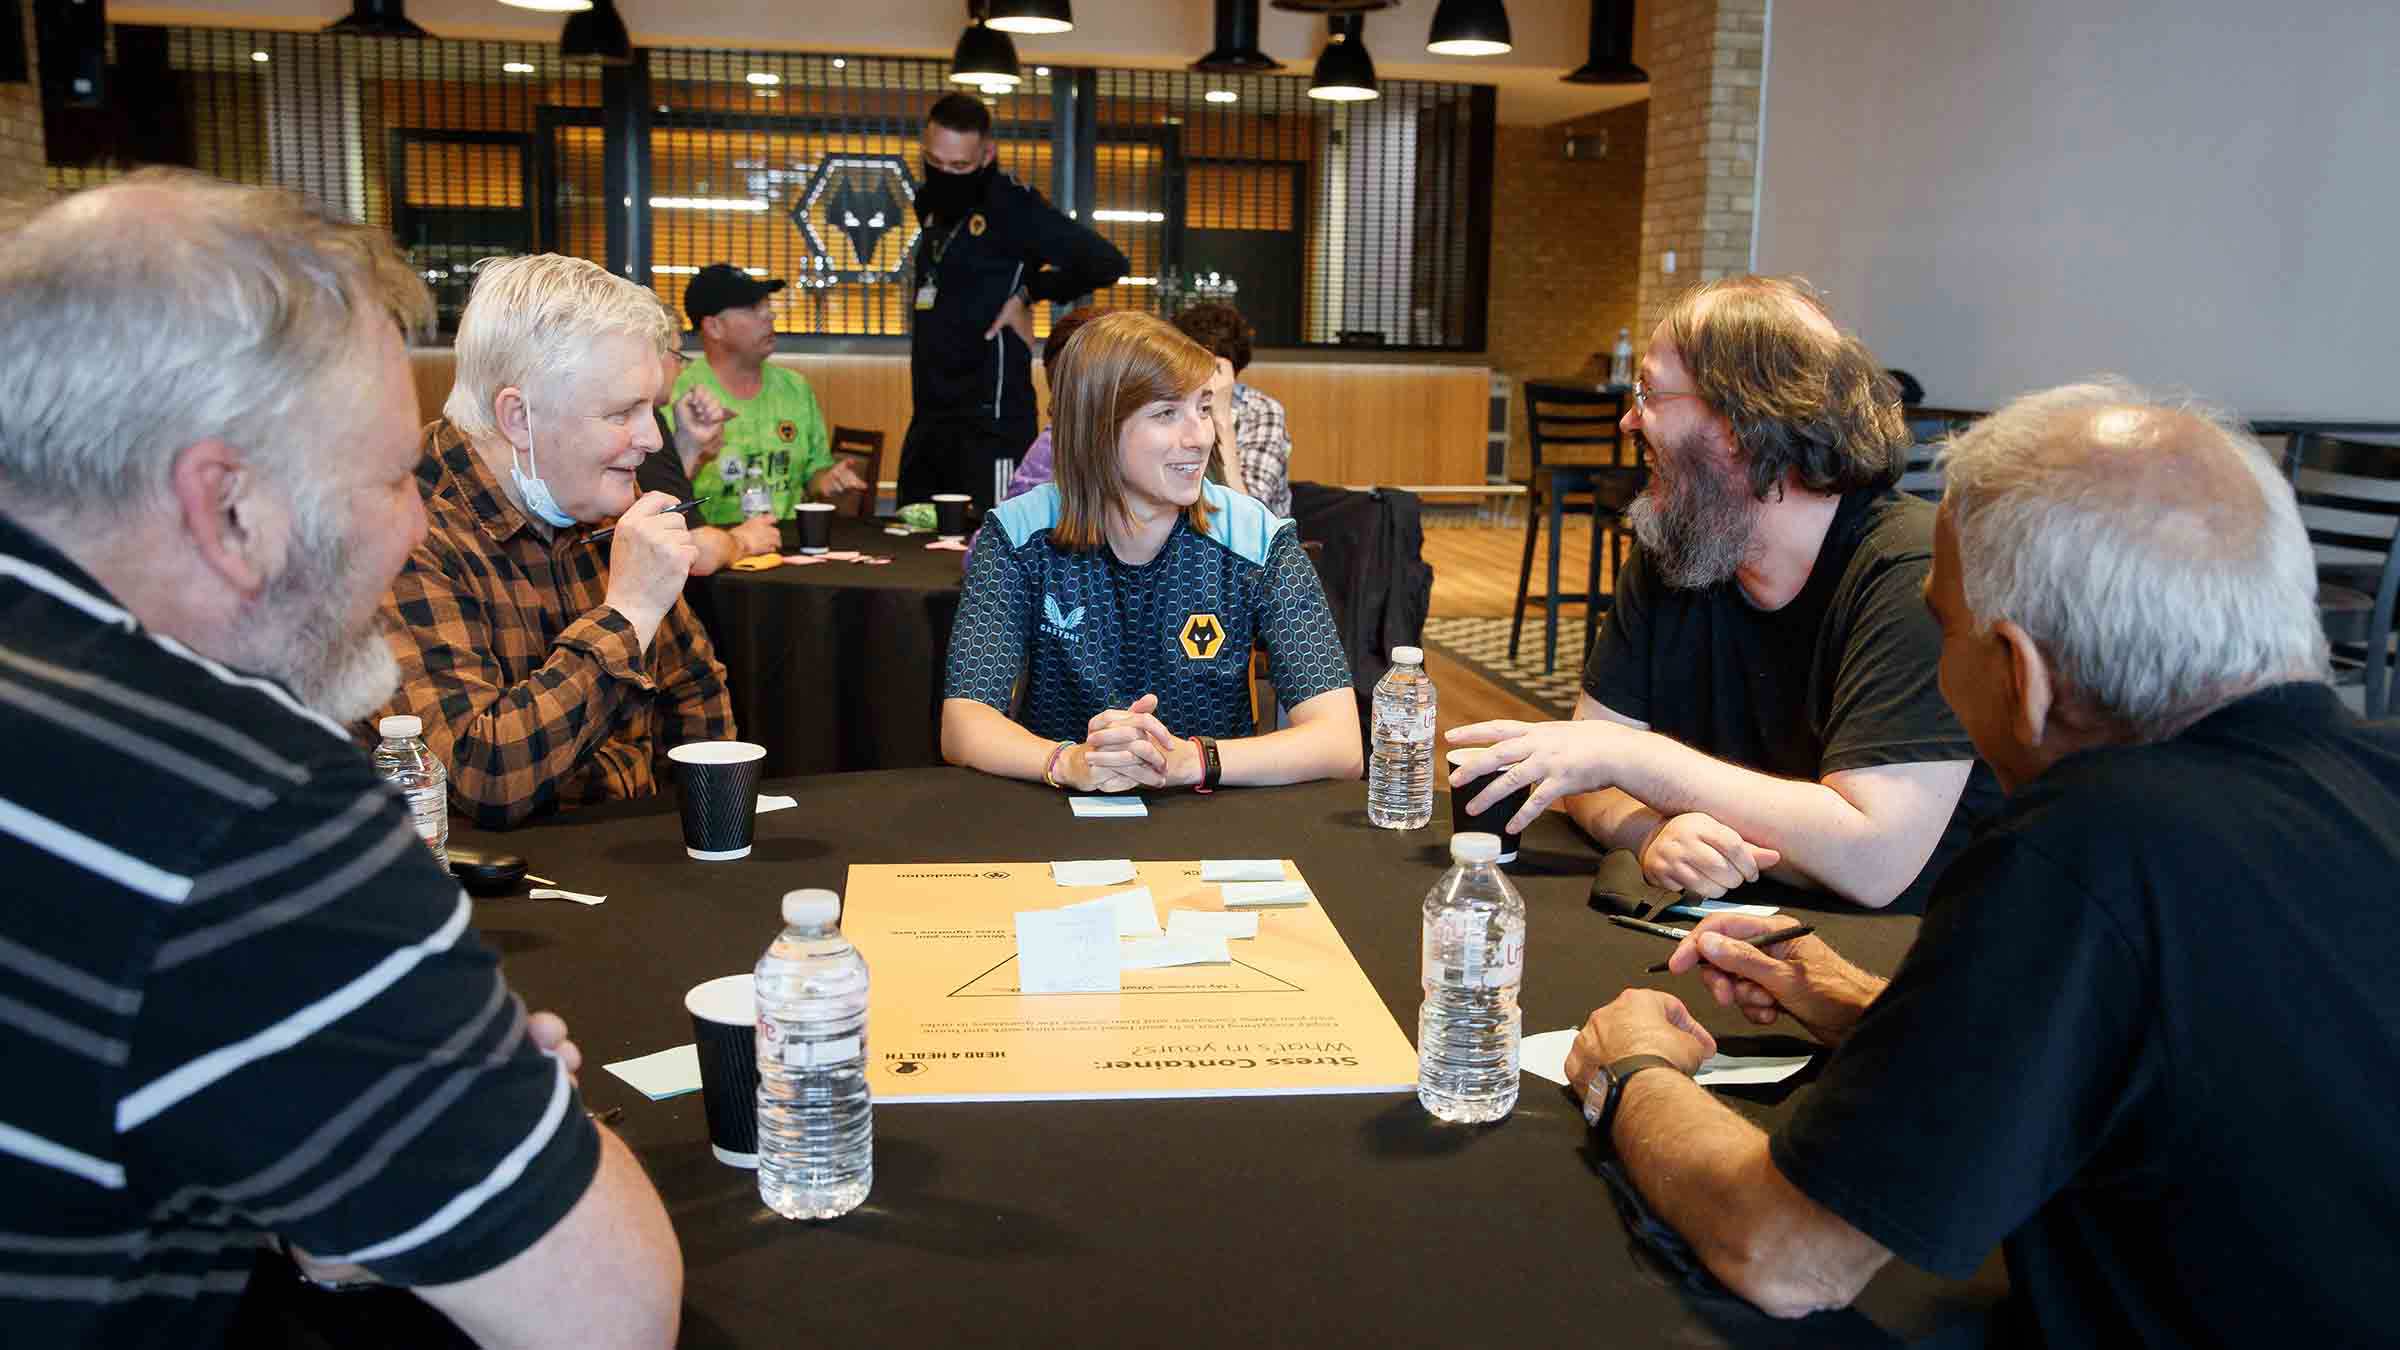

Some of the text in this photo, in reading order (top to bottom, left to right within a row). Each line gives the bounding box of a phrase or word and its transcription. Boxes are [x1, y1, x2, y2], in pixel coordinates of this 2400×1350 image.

[963, 1051, 1007, 1059] HEAD
[1131, 1042, 1352, 1057] What's in yours?
[885, 1052, 947, 1060] HEALTH
[1092, 1056, 1360, 1071] Stress Container:
